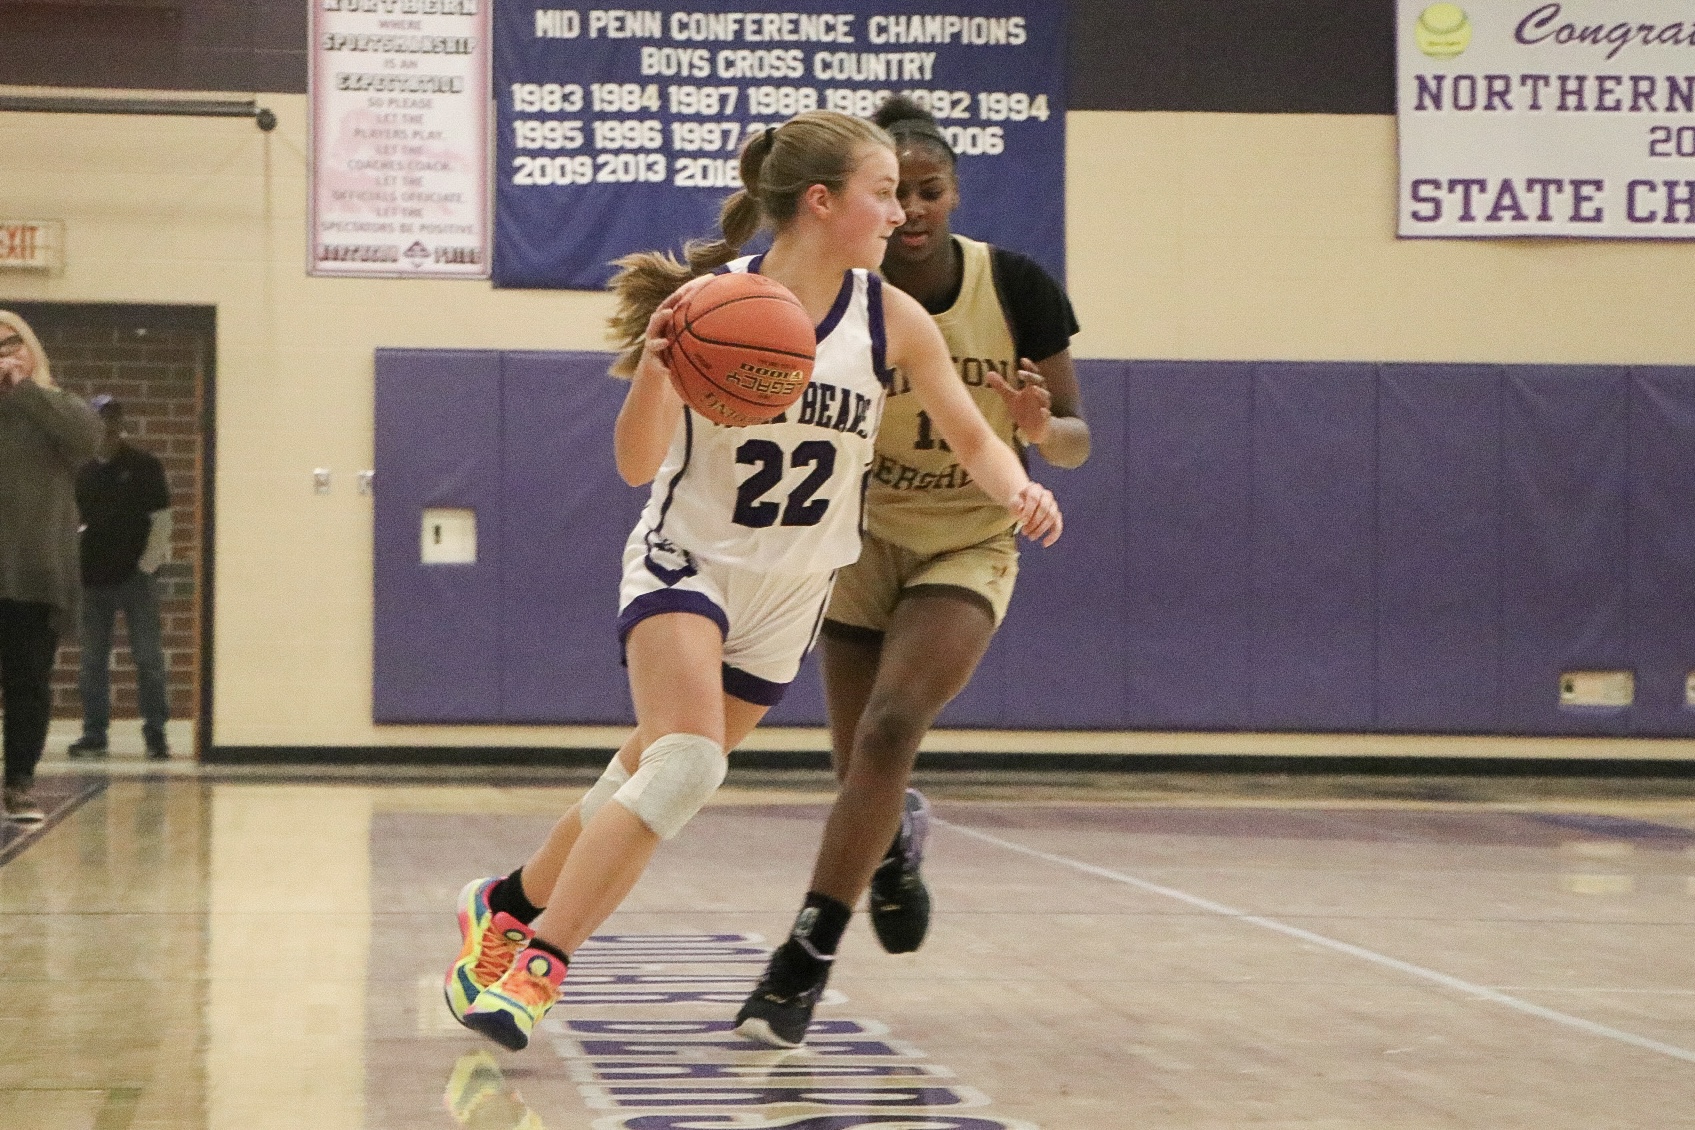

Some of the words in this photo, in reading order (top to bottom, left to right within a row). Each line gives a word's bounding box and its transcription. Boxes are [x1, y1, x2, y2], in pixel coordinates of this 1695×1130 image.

[535, 9, 581, 39] MID
[589, 10, 662, 39] PENN
[670, 11, 855, 43] CONFERENCE
[868, 15, 1028, 46] CHAMPIONS
[640, 46, 711, 78] BOYS
[716, 49, 805, 79] CROSS
[813, 51, 937, 81] COUNTRY
[511, 82, 584, 113] 1983
[590, 82, 661, 113] 1984
[667, 85, 739, 115] 1987
[747, 85, 818, 116] 1988
[977, 92, 1051, 122] 1994
[1413, 73, 1695, 112] NORTHERN
[513, 119, 584, 149] 1995
[592, 119, 663, 149] 1996
[671, 121, 741, 151] 1997
[937, 126, 1004, 155] 006
[512, 154, 594, 186] 2009
[595, 153, 667, 183] 2013
[1411, 177, 1604, 223] STATE
[732, 438, 837, 528] 22
